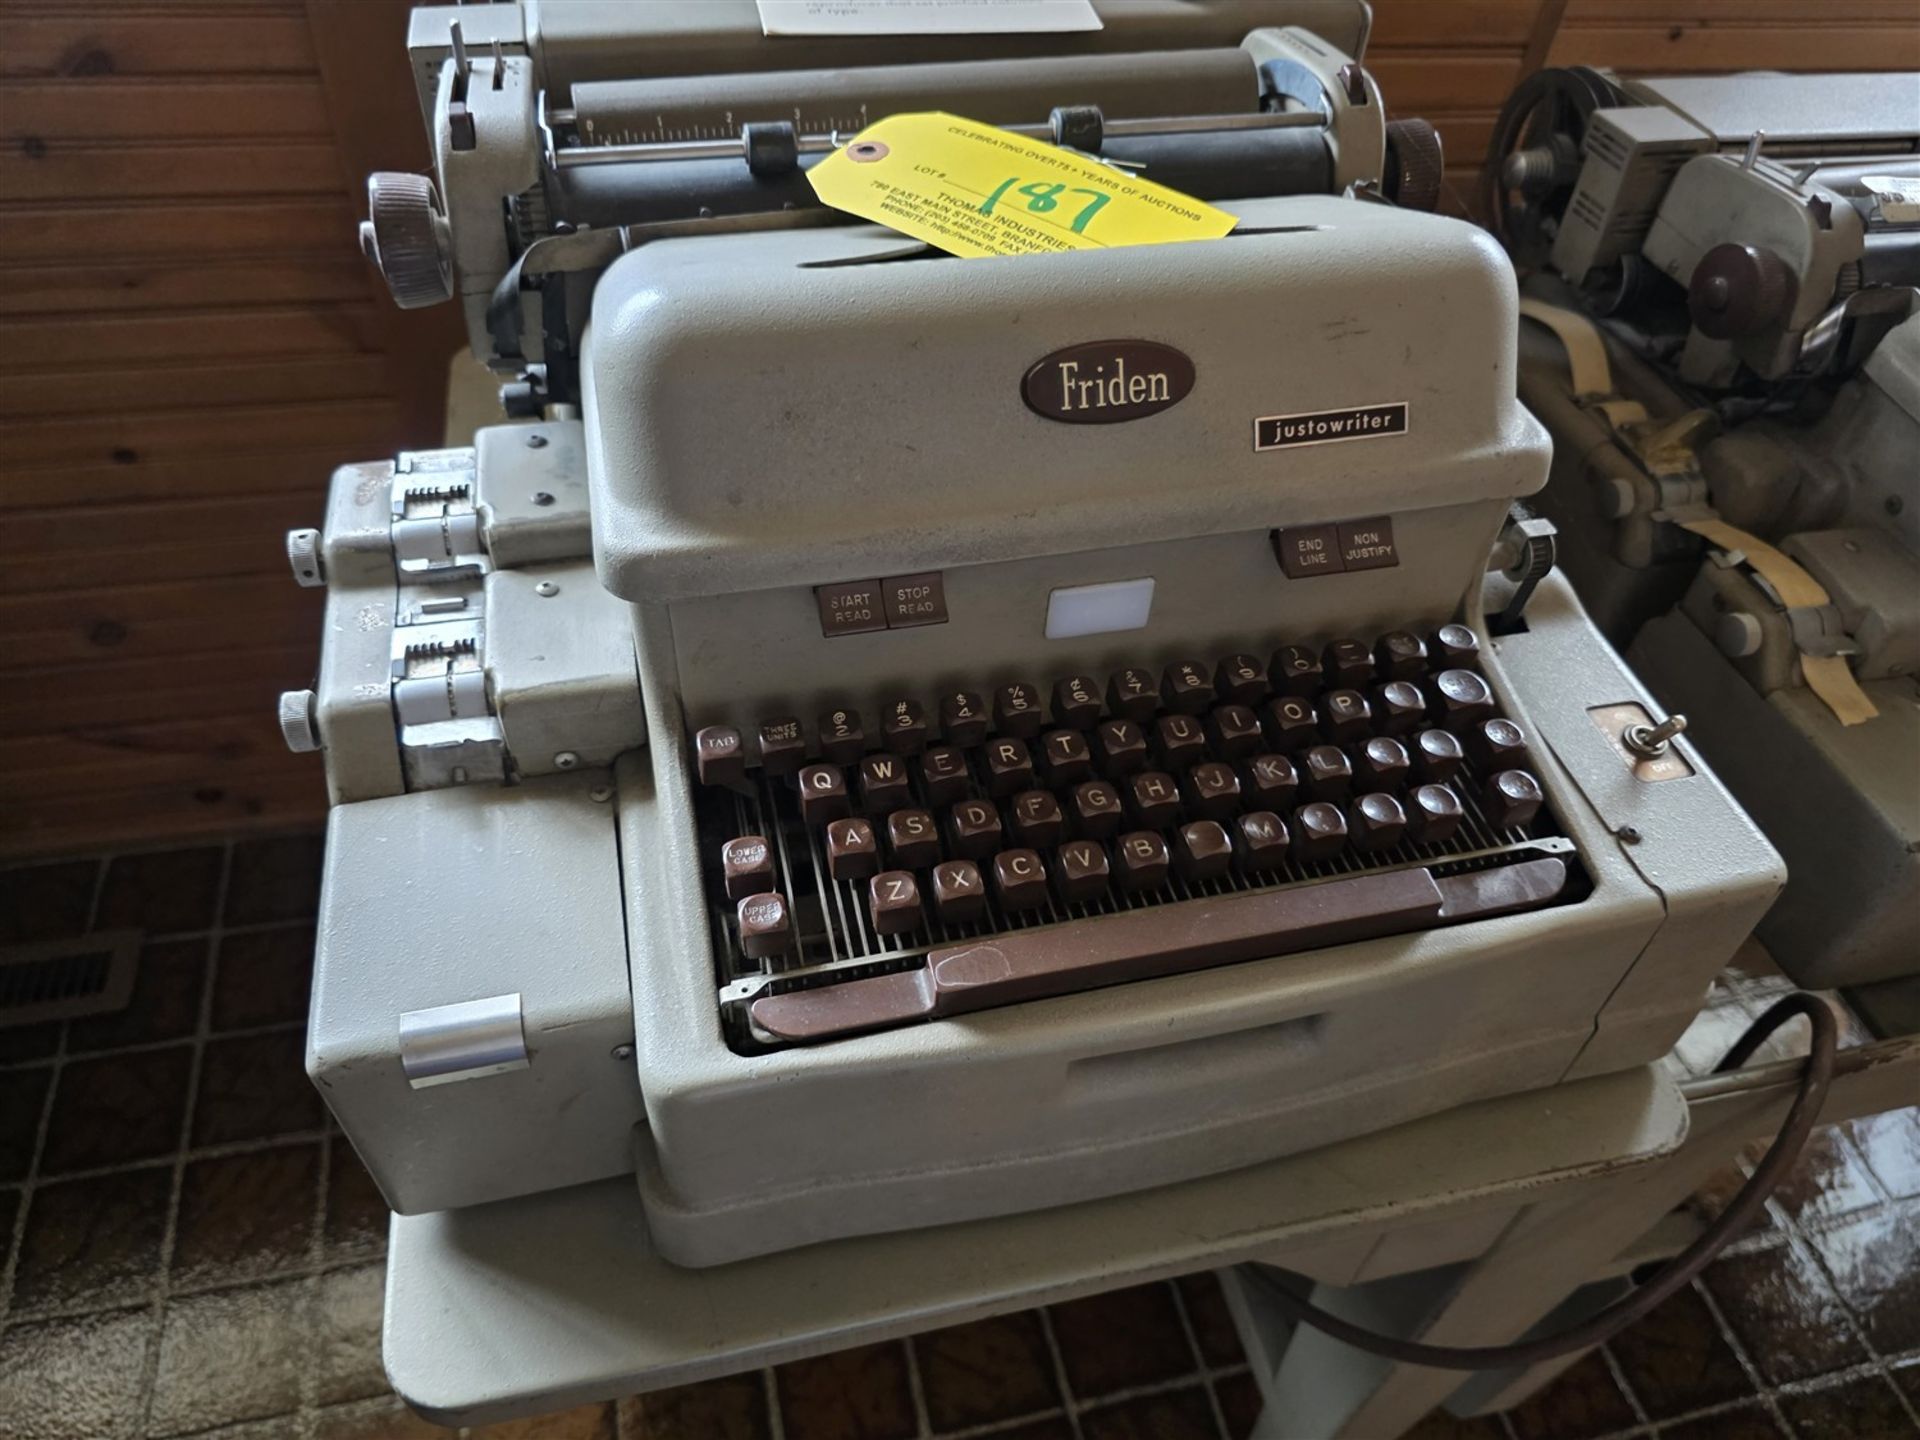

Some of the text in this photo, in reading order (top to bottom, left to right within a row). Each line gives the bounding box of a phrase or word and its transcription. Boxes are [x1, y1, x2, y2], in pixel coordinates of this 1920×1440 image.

[726, 111, 733, 123] 2
[794, 107, 800, 120] 3
[914, 164, 938, 176] LOT
[948, 126, 1024, 154] CELEBRATING
[1025, 150, 1057, 167] OVER
[1081, 169, 1120, 190] YEARS
[1121, 185, 1140, 197] OF
[1140, 193, 1202, 222] AUCTIONS
[884, 194, 925, 212] PHONE:
[890, 186, 922, 202] EAST
[922, 199, 952, 213] MAIN
[979, 178, 1111, 234] 187
[880, 202, 928, 226] WEBSITE:
[1058, 357, 1170, 411] Friden
[1273, 412, 1393, 443] justowriter
[1298, 538, 1323, 552] END
[1354, 533, 1379, 545] NON
[1300, 553, 1328, 566] LINE
[1346, 545, 1392, 560] JUSTIFY
[831, 593, 871, 609] START
[897, 586, 930, 600] STOP
[836, 609, 872, 623] READ
[899, 602, 934, 614] READ
[1186, 675, 1200, 686] 8
[1239, 667, 1255, 679] 9
[1008, 686, 1025, 698] %
[1128, 682, 1142, 693] 7
[956, 693, 967, 705] $
[1012, 698, 1028, 710] 5
[1073, 691, 1089, 702] 6
[1336, 696, 1352, 711] P
[896, 702, 907, 714] #
[958, 707, 973, 717] 4
[1284, 703, 1302, 719] O
[833, 711, 846, 725] @
[897, 715, 913, 727] 3
[1232, 711, 1242, 727] I
[764, 722, 798, 734] THREE
[836, 725, 850, 737] 2
[1112, 725, 1127, 742] Y
[1170, 719, 1189, 737] U
[708, 736, 736, 748] TAB
[767, 731, 797, 742] UNITS
[1056, 735, 1071, 753] T
[1000, 745, 1018, 762] R
[1317, 754, 1338, 769] L
[873, 760, 893, 778] W
[934, 753, 952, 771] E
[1263, 760, 1285, 778] K
[813, 771, 832, 790] Q
[1209, 770, 1224, 787] J
[1145, 779, 1165, 797] H
[1087, 789, 1107, 806] G
[1026, 798, 1042, 816] F
[967, 807, 986, 825] D
[905, 816, 923, 834] S
[1251, 820, 1274, 838] M
[845, 828, 862, 846] A
[729, 844, 766, 857] LOWER
[1133, 839, 1153, 857] B
[734, 855, 762, 865] CASE
[1012, 857, 1030, 875] C
[1074, 849, 1089, 867] V
[950, 869, 969, 888] X
[886, 880, 905, 900] Z
[744, 901, 781, 915] UPPER
[749, 912, 778, 924] CASE
